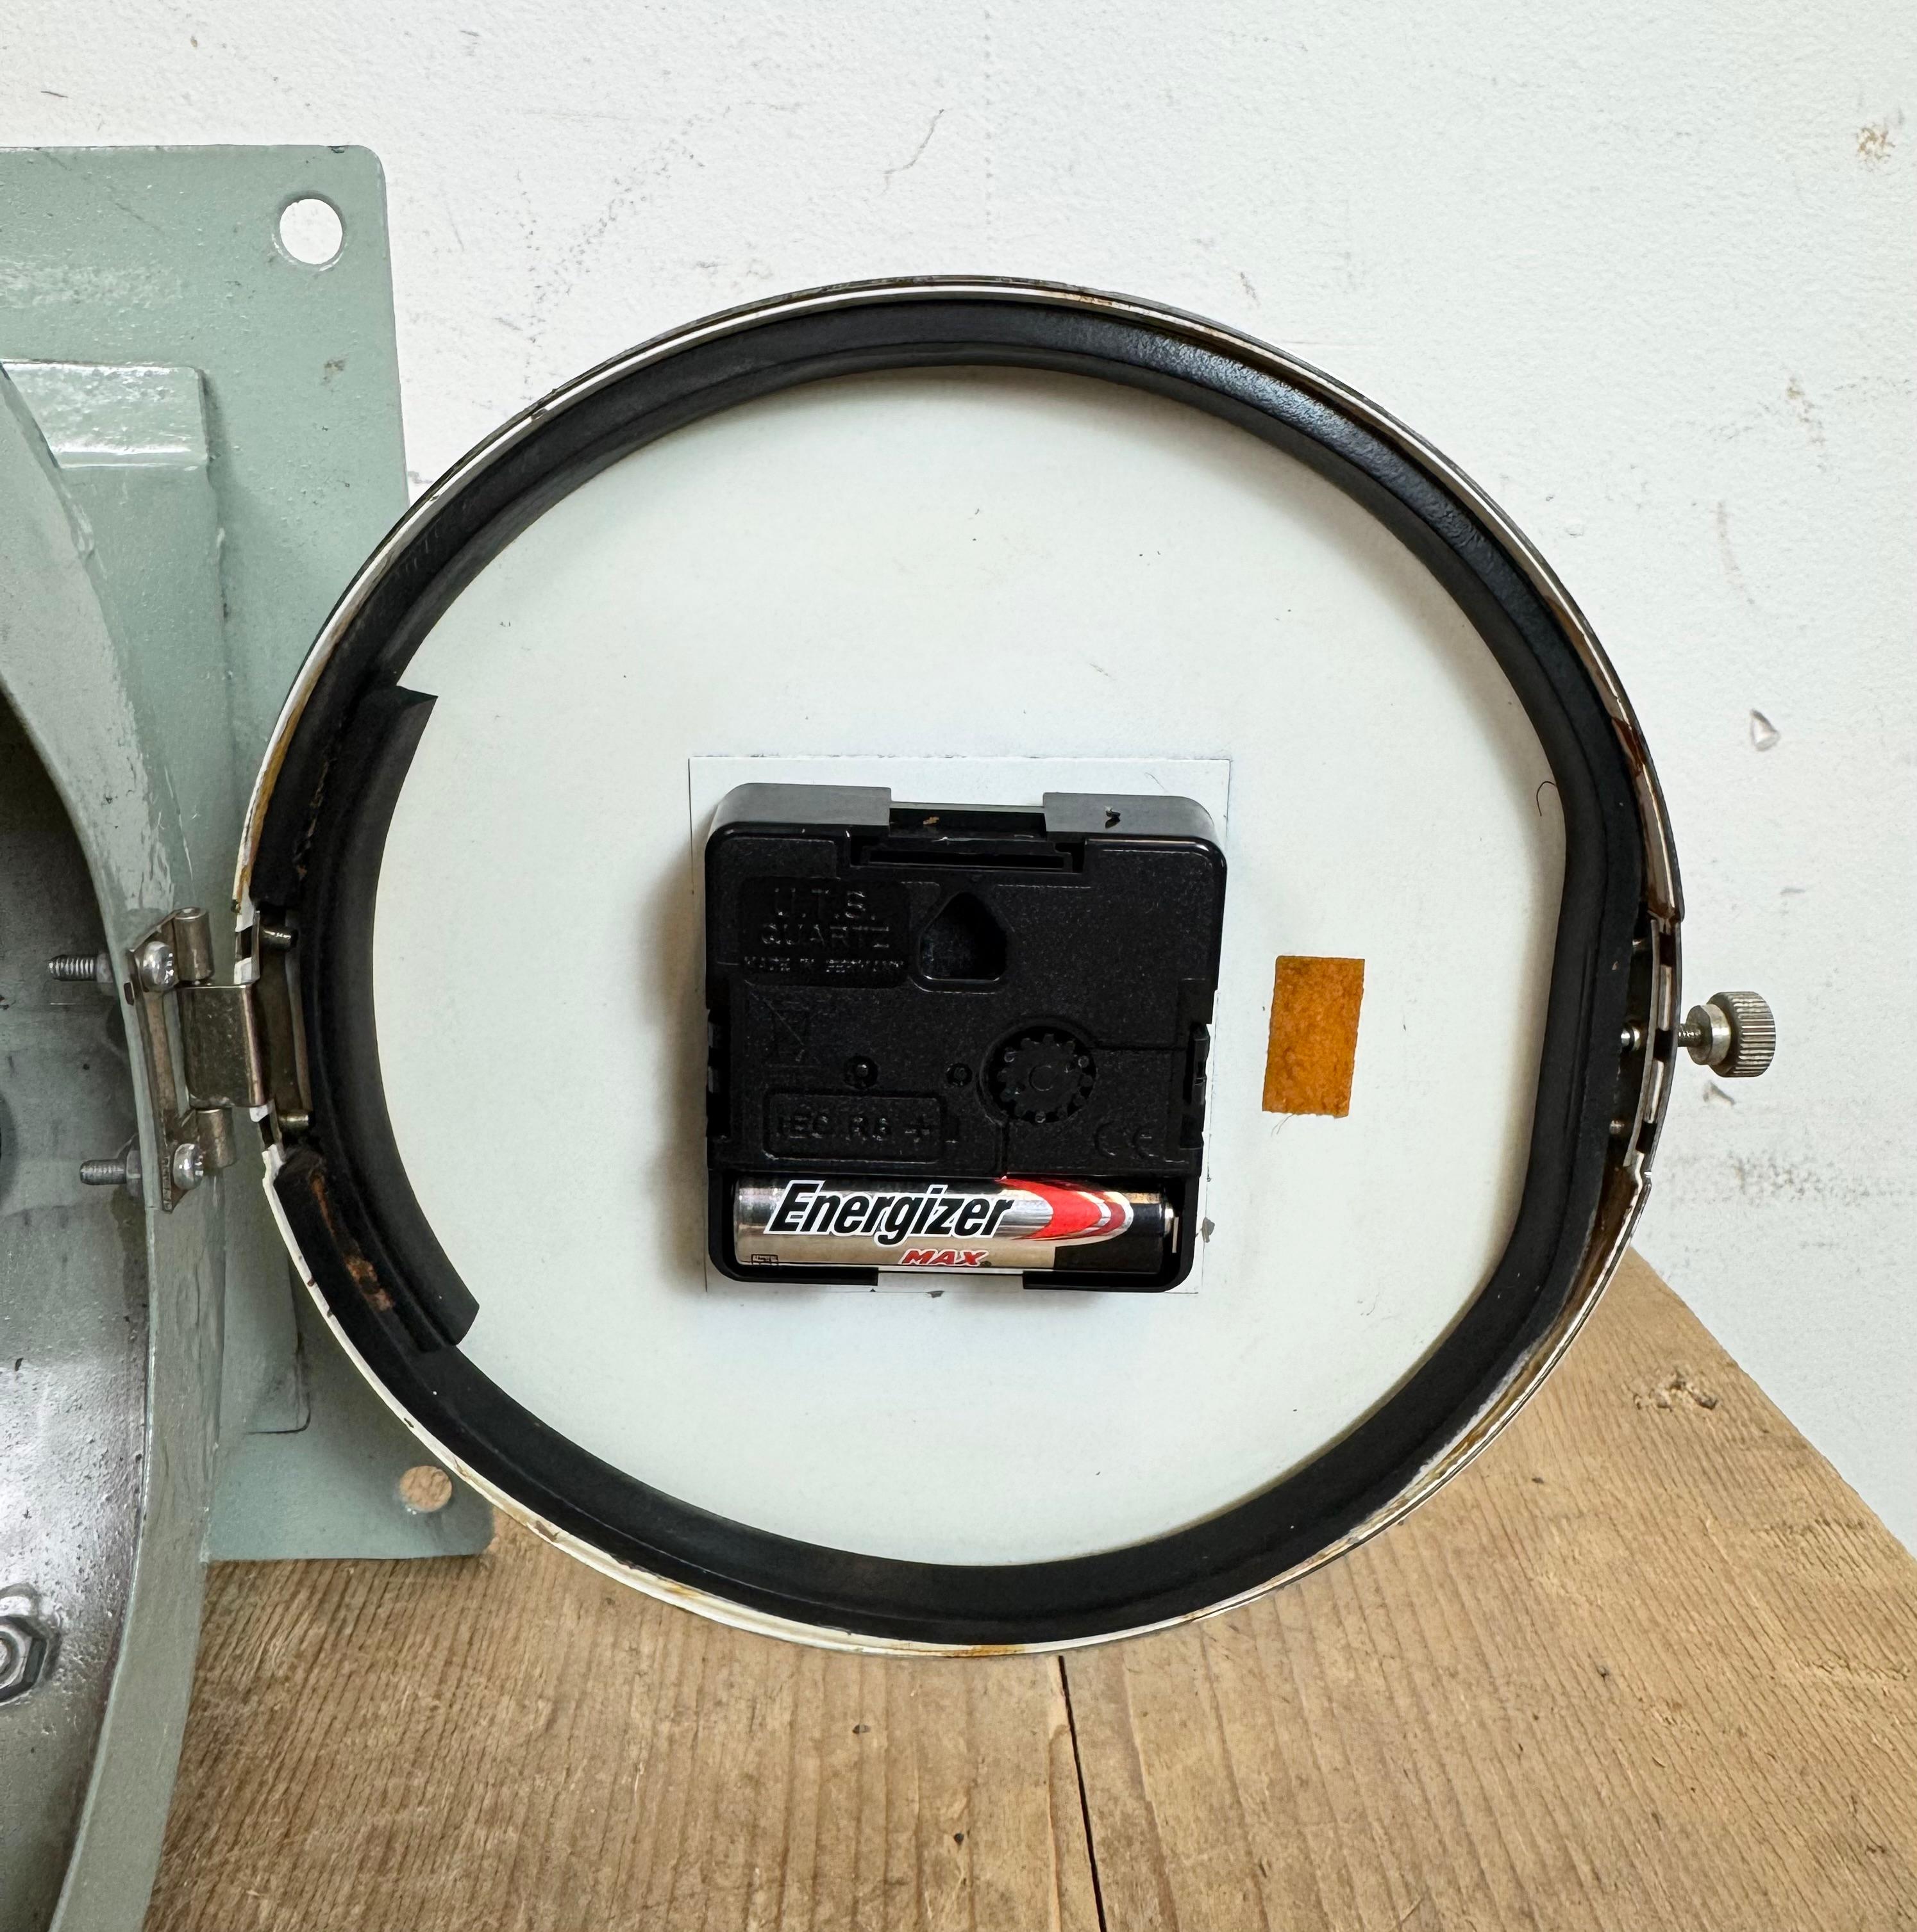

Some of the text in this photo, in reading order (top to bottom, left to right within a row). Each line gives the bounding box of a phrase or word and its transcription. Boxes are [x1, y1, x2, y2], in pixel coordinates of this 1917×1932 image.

[773, 886, 876, 920] U.T.S.
[760, 922, 891, 949] QUARTZ
[744, 956, 905, 974] MADE IN GERMANY
[777, 1113, 830, 1140] IEC
[846, 1114, 892, 1141] R6
[764, 1180, 1014, 1245] Energizer
[899, 1249, 988, 1266] MAX
